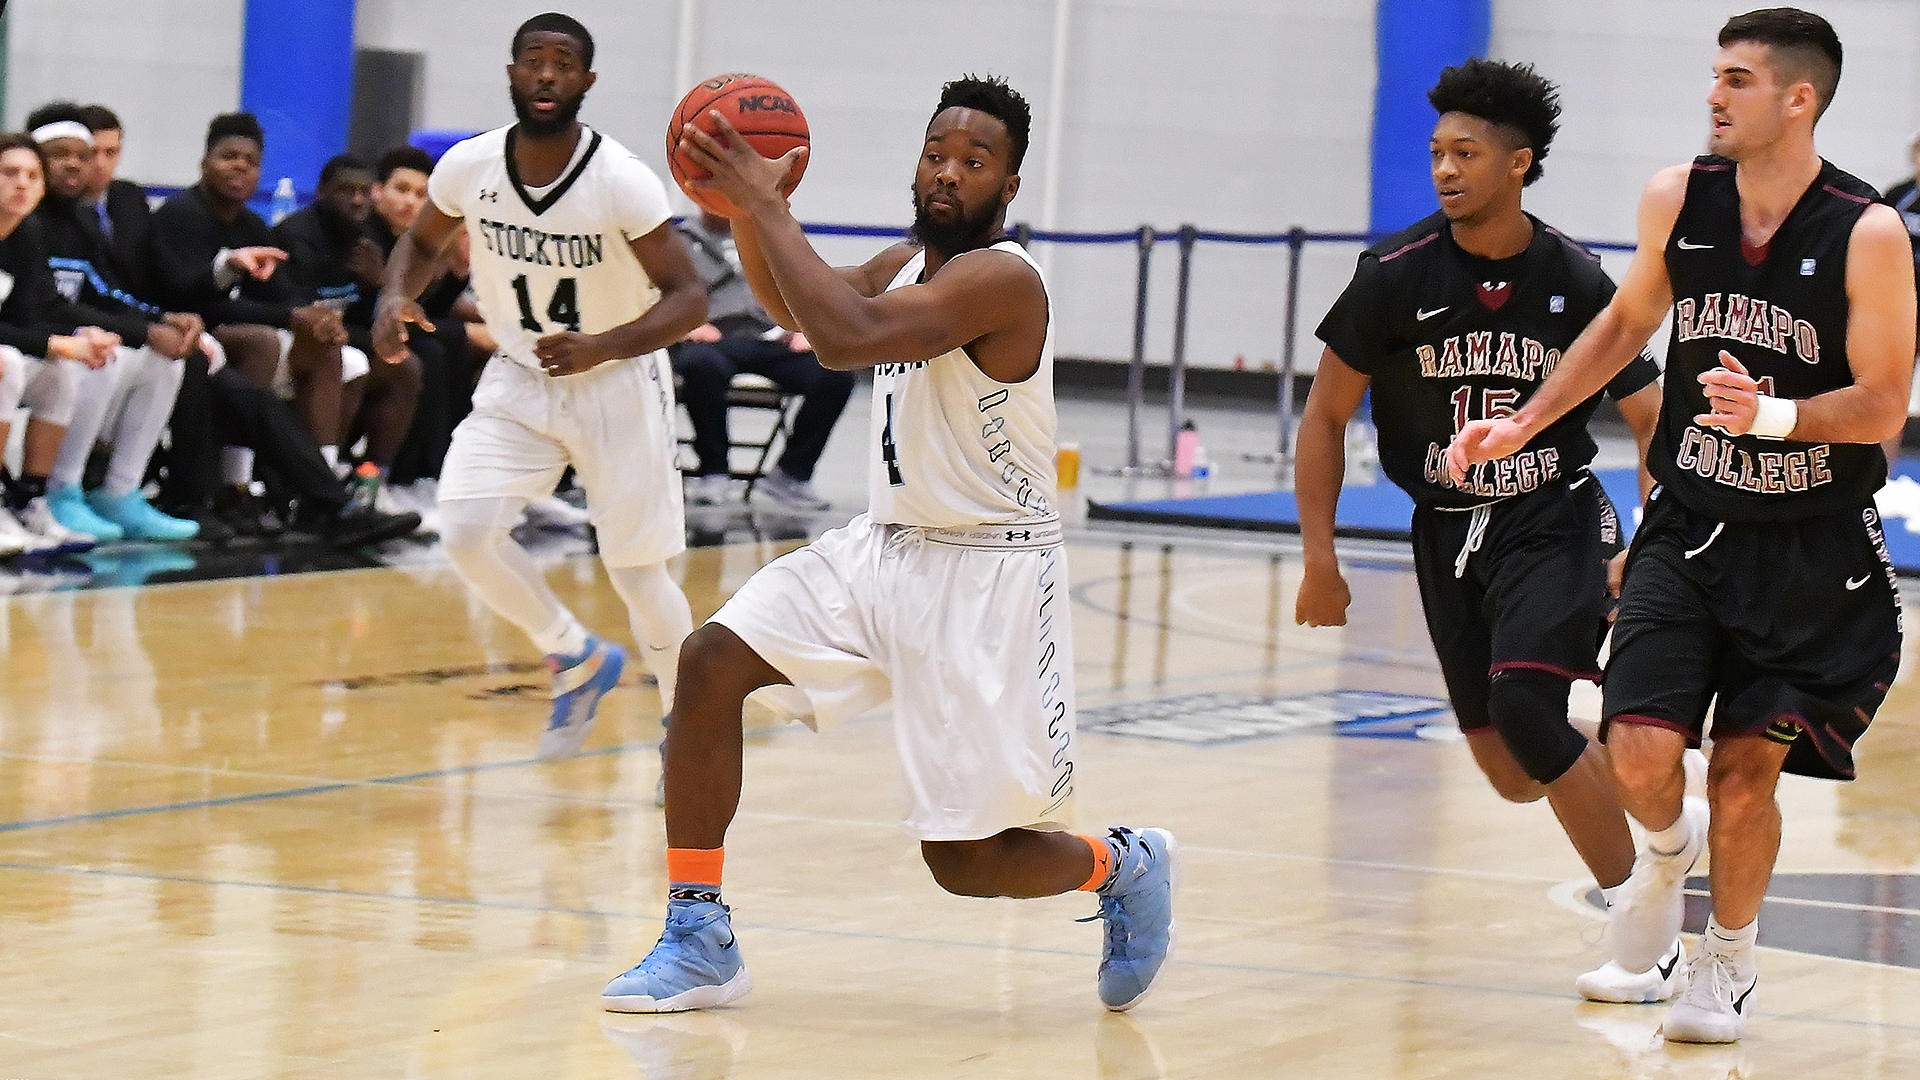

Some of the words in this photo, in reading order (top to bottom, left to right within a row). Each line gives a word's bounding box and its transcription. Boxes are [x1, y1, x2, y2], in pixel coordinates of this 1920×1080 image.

[738, 95, 797, 116] NCAA
[480, 218, 603, 269] STOCKTON
[511, 273, 580, 333] 14
[1675, 293, 1820, 364] RAMAPO
[1416, 330, 1561, 382] RAMAPO
[877, 391, 905, 488] 4
[1676, 426, 1833, 494] COLLEGE
[1424, 441, 1561, 498] COLEGE
